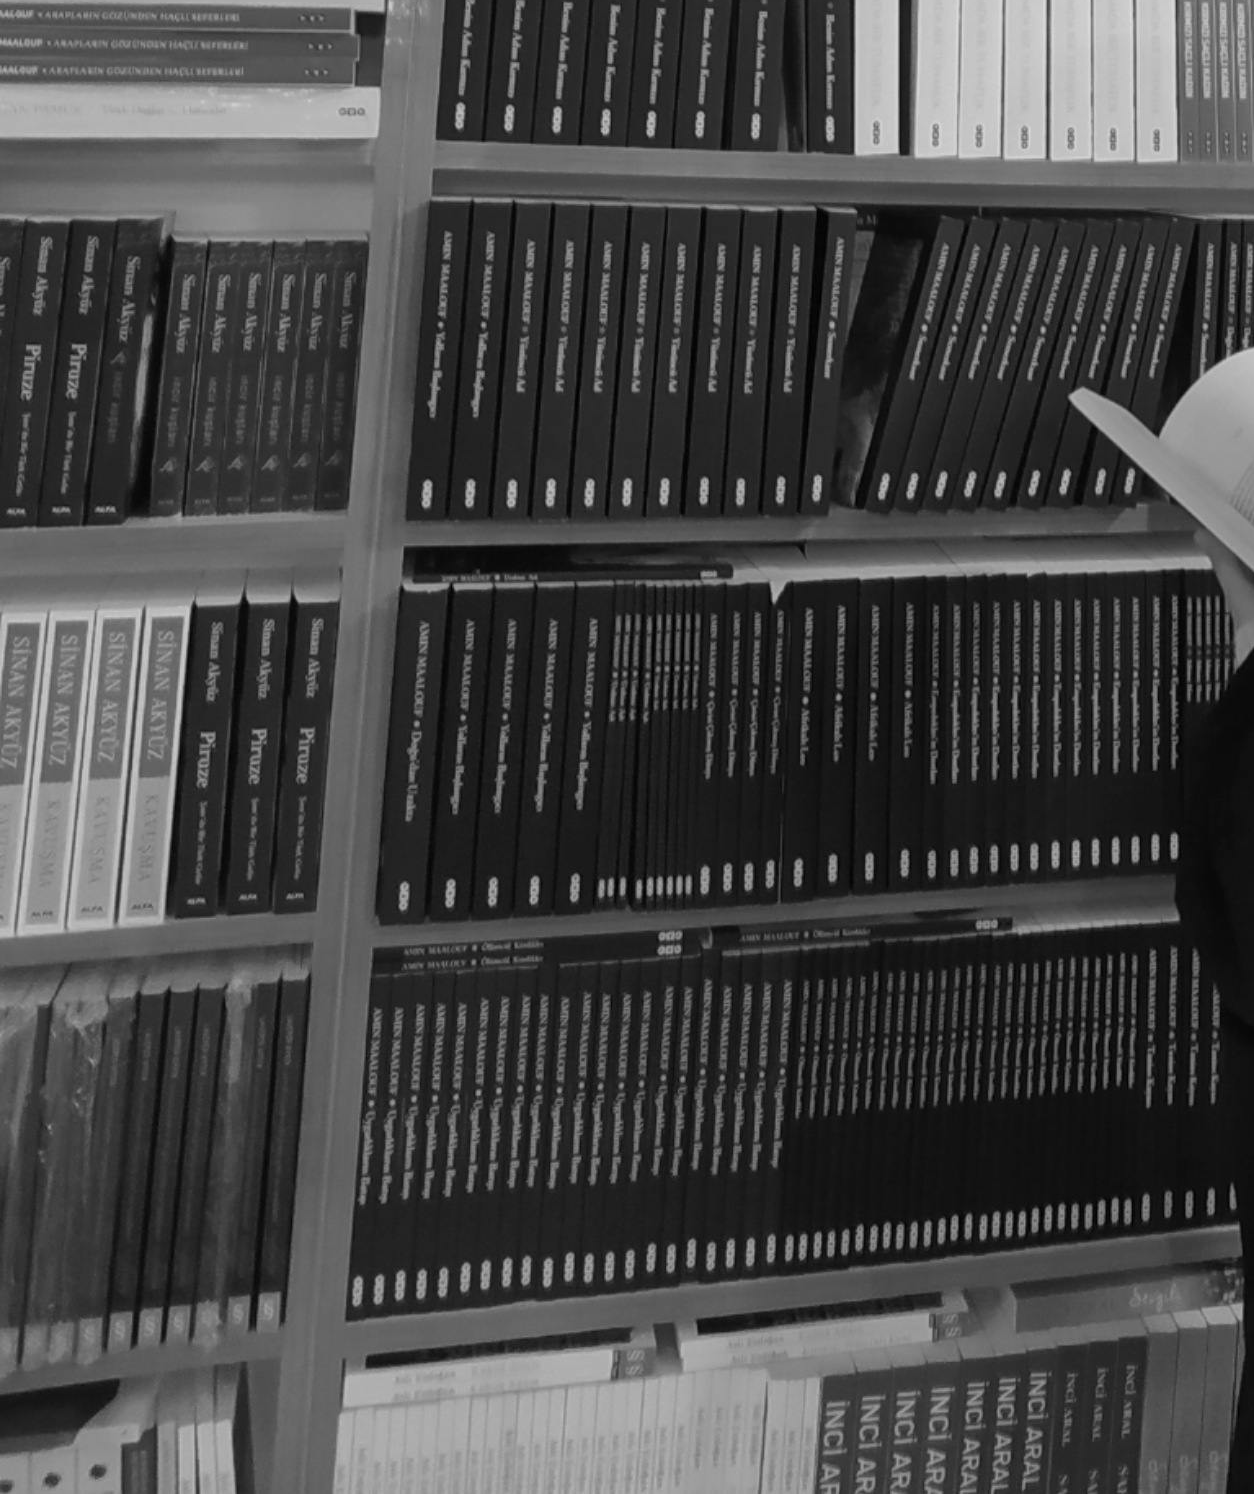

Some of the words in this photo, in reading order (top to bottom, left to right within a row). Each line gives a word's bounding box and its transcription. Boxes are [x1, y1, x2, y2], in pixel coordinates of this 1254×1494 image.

[36, 236, 53, 273] Sinan
[83, 235, 99, 272] Sinan
[123, 255, 140, 295] Sinan
[31, 275, 48, 315] Akyüz
[78, 275, 94, 314] Akyüz
[180, 273, 195, 311] Sinan
[116, 298, 135, 342] Akyüz
[174, 313, 191, 353] Akyüz
[20, 344, 41, 400] Piruze
[65, 343, 87, 399] Piruze
[153, 630, 176, 690] SİNAN
[209, 621, 223, 659] Sinan
[260, 618, 275, 656] Sinan
[309, 617, 324, 655] Sinan
[7, 636, 31, 697] SİNAN
[56, 634, 80, 694] SİNAN
[104, 631, 127, 691] SİNAN
[204, 661, 220, 701] Akyüz
[256, 658, 272, 699] Akyüz
[304, 657, 320, 698] Akyüz
[413, 655, 427, 717] MAALOUF
[48, 702, 71, 765] AKYÜZ
[97, 699, 119, 762] AKYÜZ
[147, 698, 166, 759] AKYÜZ
[196, 731, 216, 788] Piruze
[248, 728, 267, 784] Piruze
[295, 727, 315, 783] Piruze
[964, 1381, 988, 1430] İNCİ
[995, 1377, 1020, 1426] İNCİ
[1026, 1371, 1051, 1419] İNCİ
[1064, 1372, 1078, 1403] İNCİ
[1094, 1367, 1108, 1398] İNCİ
[858, 1395, 885, 1449] İNCİ
[893, 1390, 920, 1444] İNCİ
[990, 1433, 1011, 1494] ARAL
[1021, 1426, 1043, 1490] ARAL
